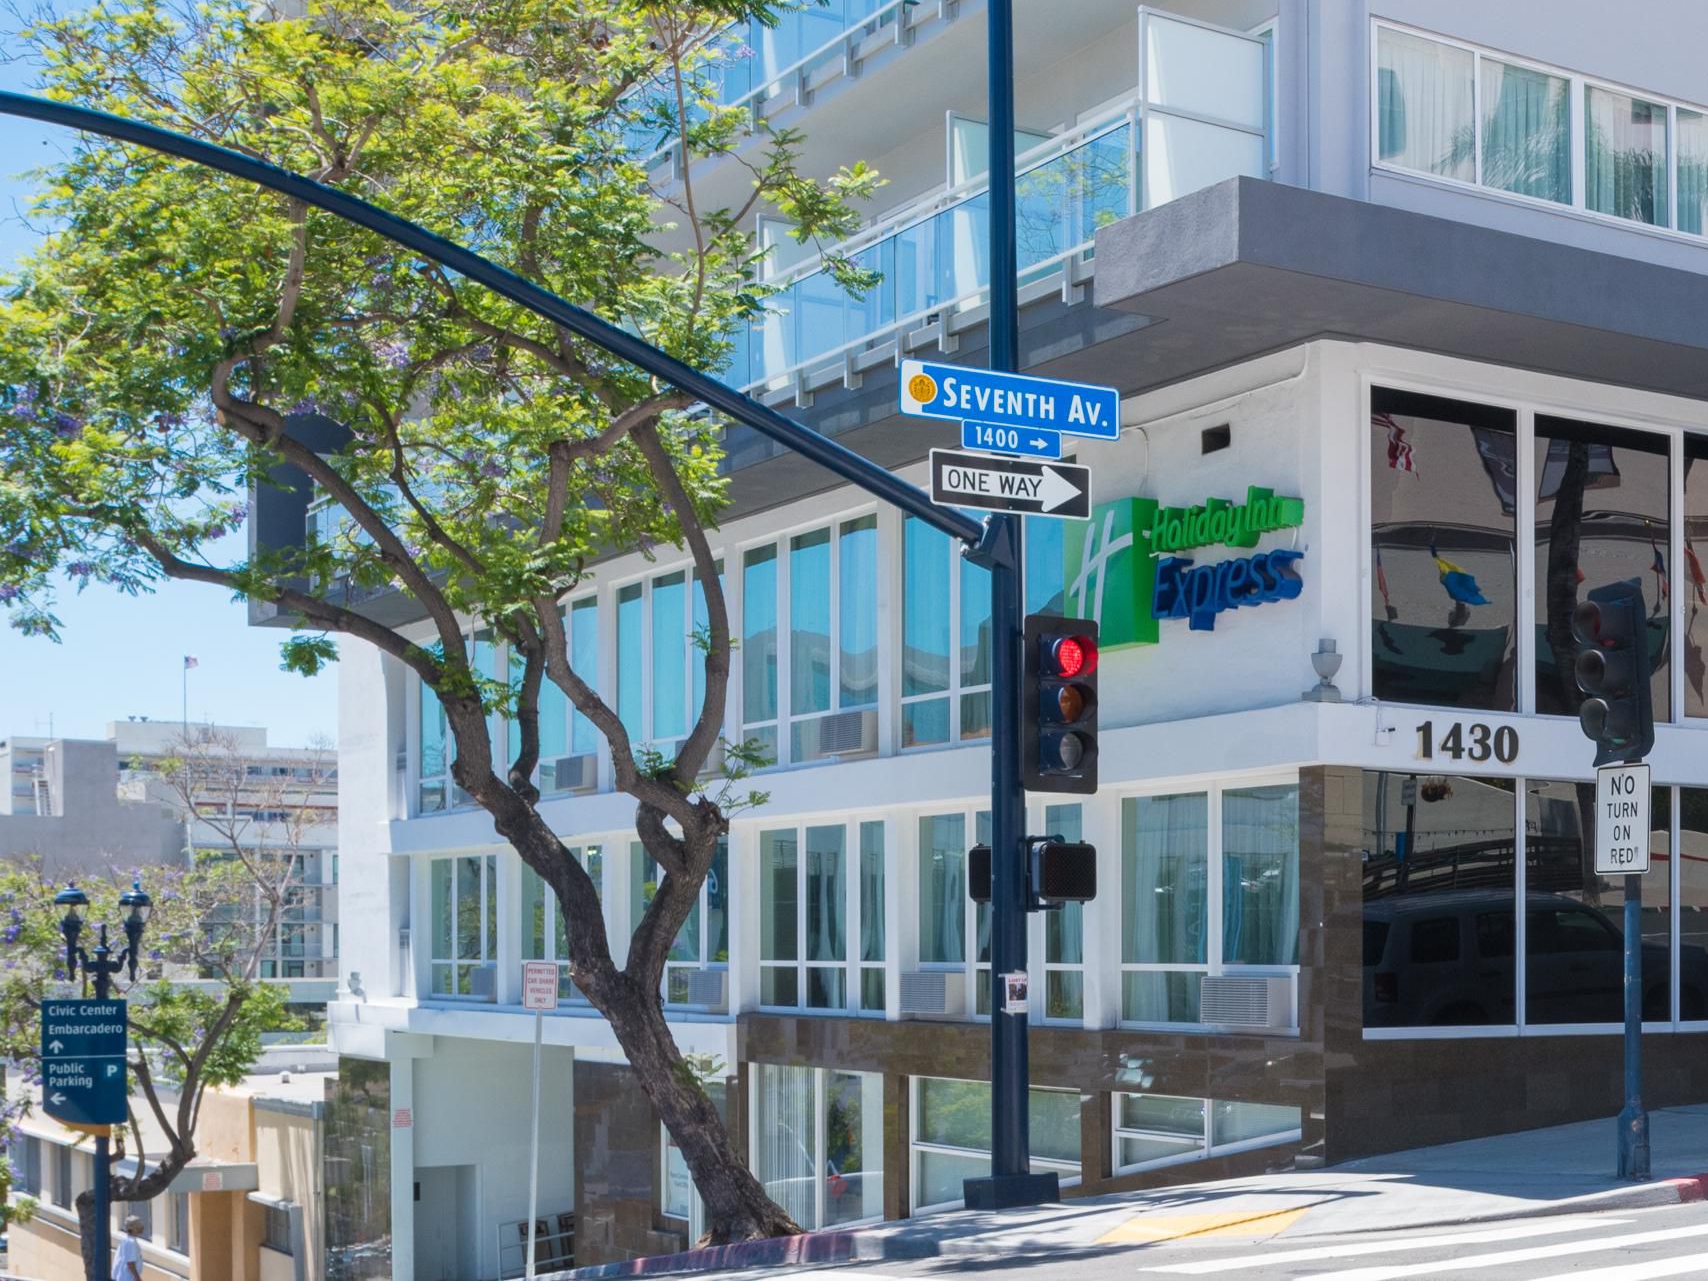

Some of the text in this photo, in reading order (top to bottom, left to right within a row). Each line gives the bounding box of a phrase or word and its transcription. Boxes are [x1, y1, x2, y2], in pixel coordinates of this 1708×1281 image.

[943, 377, 1055, 420] SEVENTH
[975, 426, 1019, 449] 1400
[949, 469, 1042, 497] ONE WAY
[1150, 485, 1301, 552] Holiday Inn
[1152, 549, 1303, 631] Express
[1416, 720, 1519, 764] 1430
[1611, 775, 1635, 796] NO
[1607, 801, 1638, 819] TURN
[1613, 824, 1631, 842] ON
[1610, 847, 1634, 865] RED
[48, 1005, 118, 1016] Civic Center
[48, 1023, 123, 1035] Embarcadero
[49, 1063, 85, 1074] Public
[106, 1064, 118, 1077] P
[49, 1076, 93, 1089] Parking
